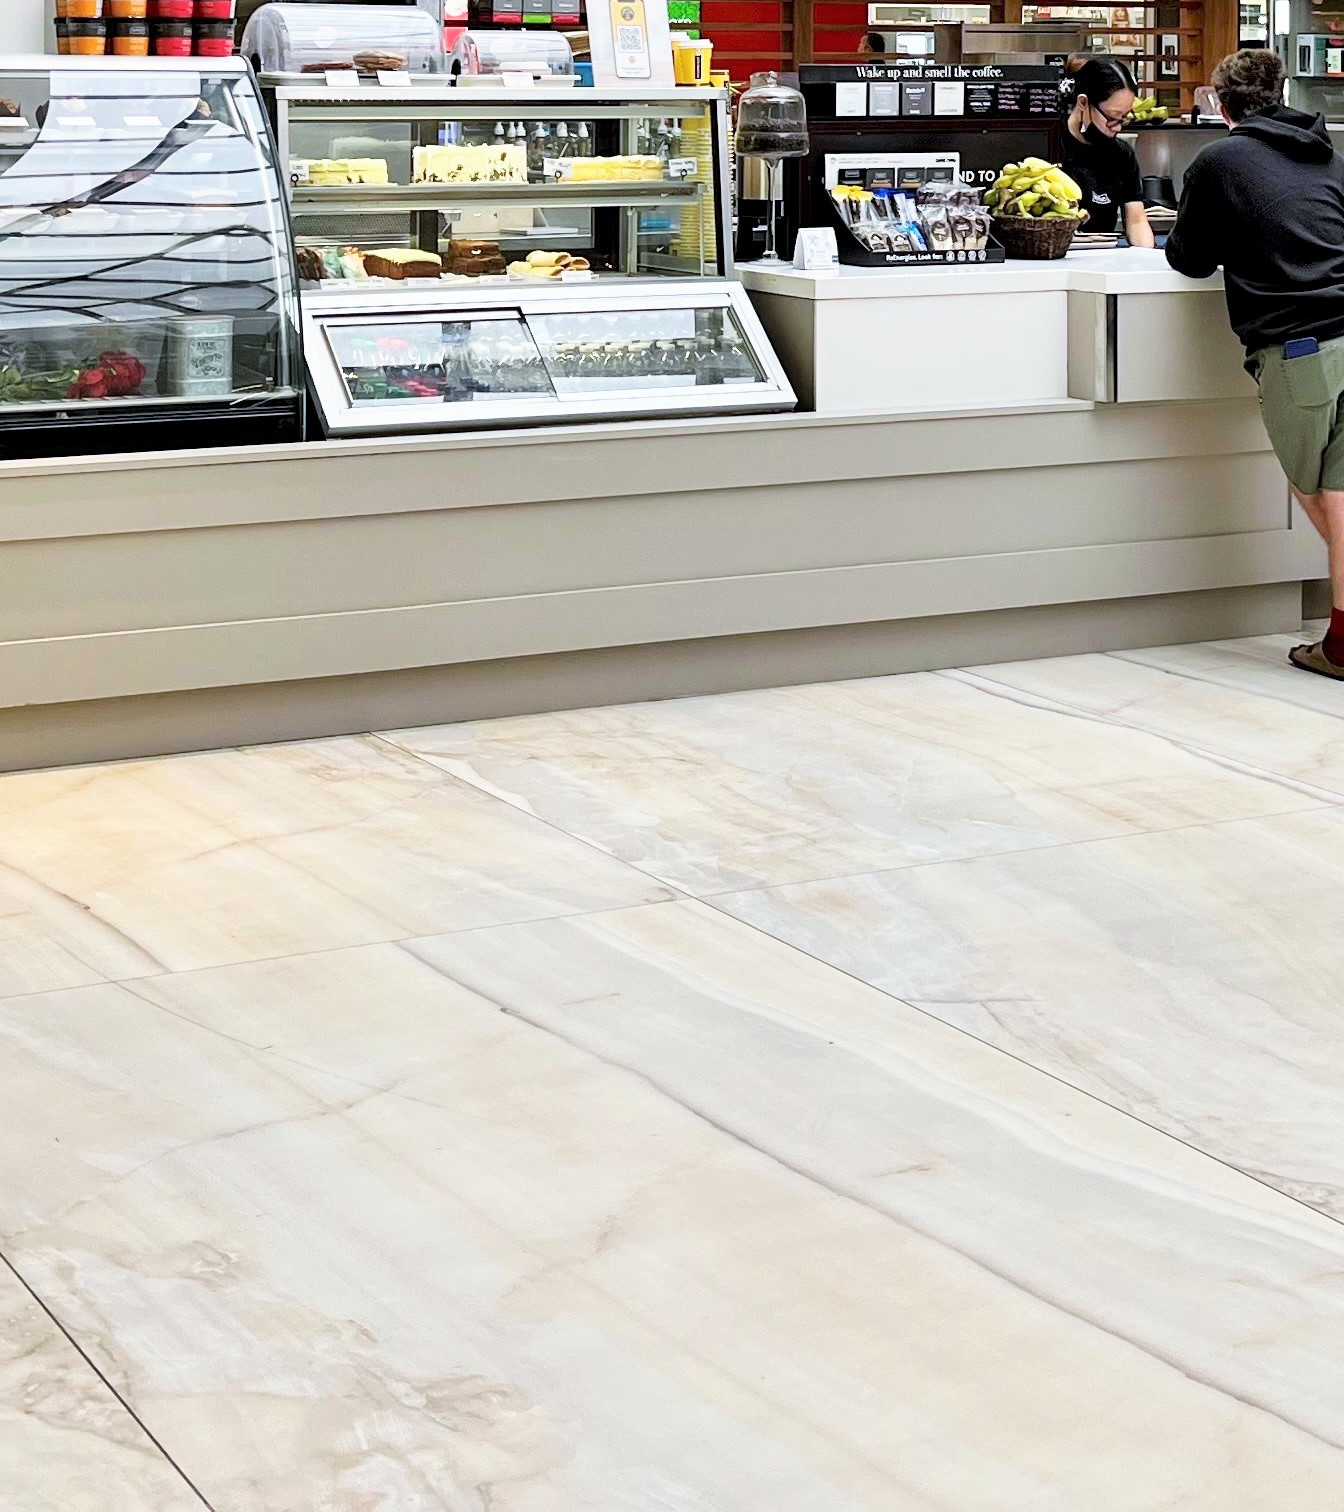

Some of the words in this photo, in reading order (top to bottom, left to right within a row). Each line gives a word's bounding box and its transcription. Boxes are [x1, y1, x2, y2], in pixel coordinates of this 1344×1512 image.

[857, 67, 885, 78] Wake
[887, 69, 900, 80] up
[903, 67, 923, 78] and
[925, 67, 951, 78] smell
[954, 67, 970, 78] the
[972, 67, 1004, 78] coffee.
[977, 170, 996, 182] TO
